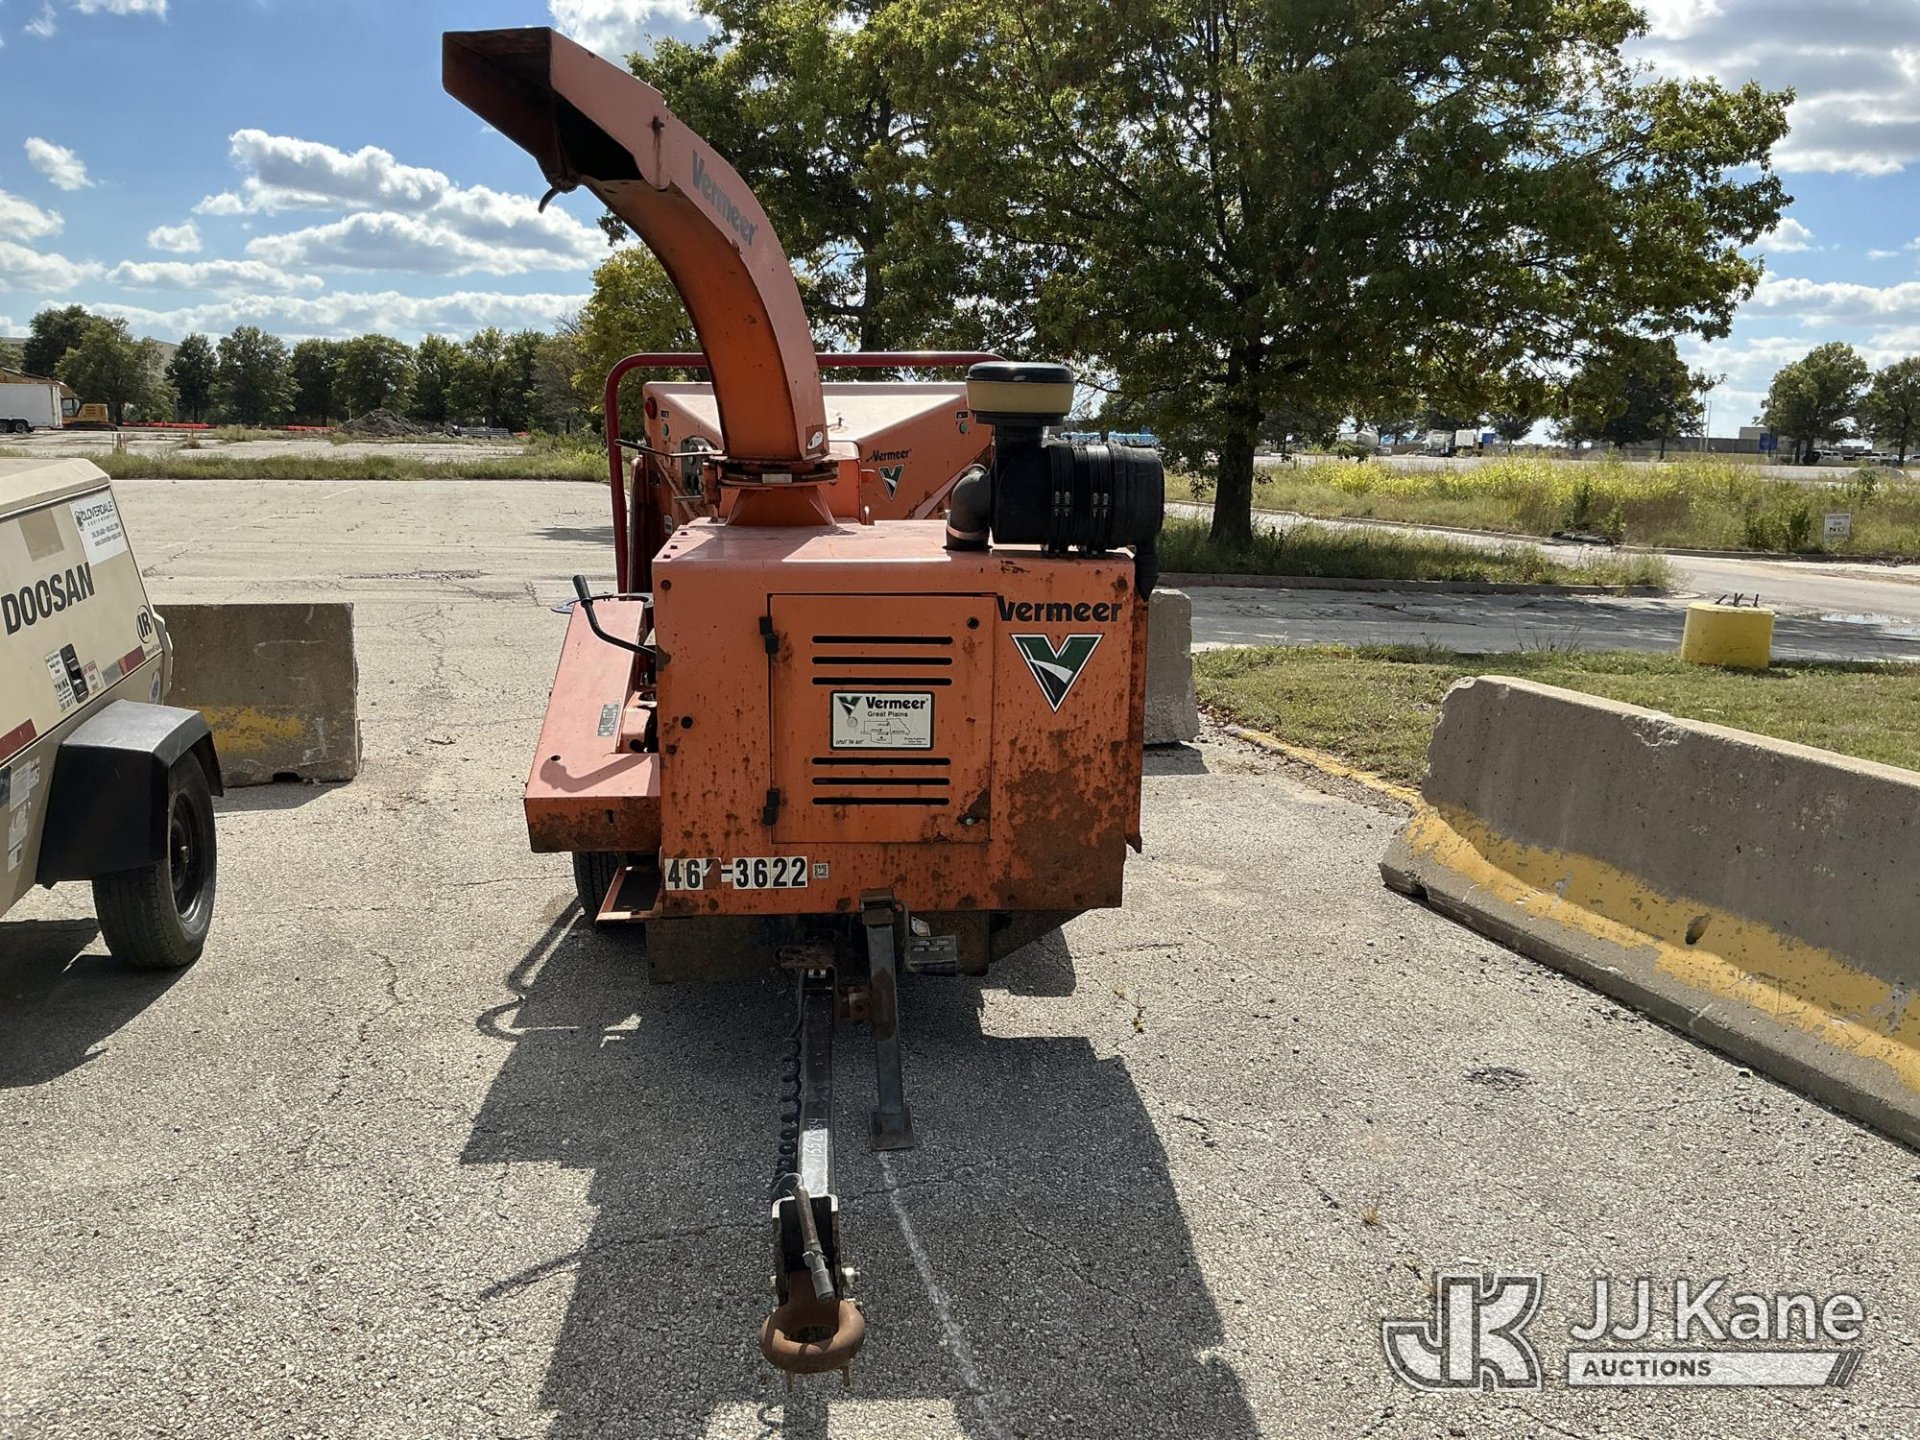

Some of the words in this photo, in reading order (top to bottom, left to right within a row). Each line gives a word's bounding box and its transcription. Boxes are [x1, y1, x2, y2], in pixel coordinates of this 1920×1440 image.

[692, 149, 758, 246] Vermeer
[872, 450, 910, 461] Vermeer
[0, 562, 95, 635] DOOSAN
[996, 595, 1122, 622] Vermeer
[137, 611, 152, 638] IR
[865, 696, 926, 709] Vermeer
[667, 857, 806, 889] 46-3622
